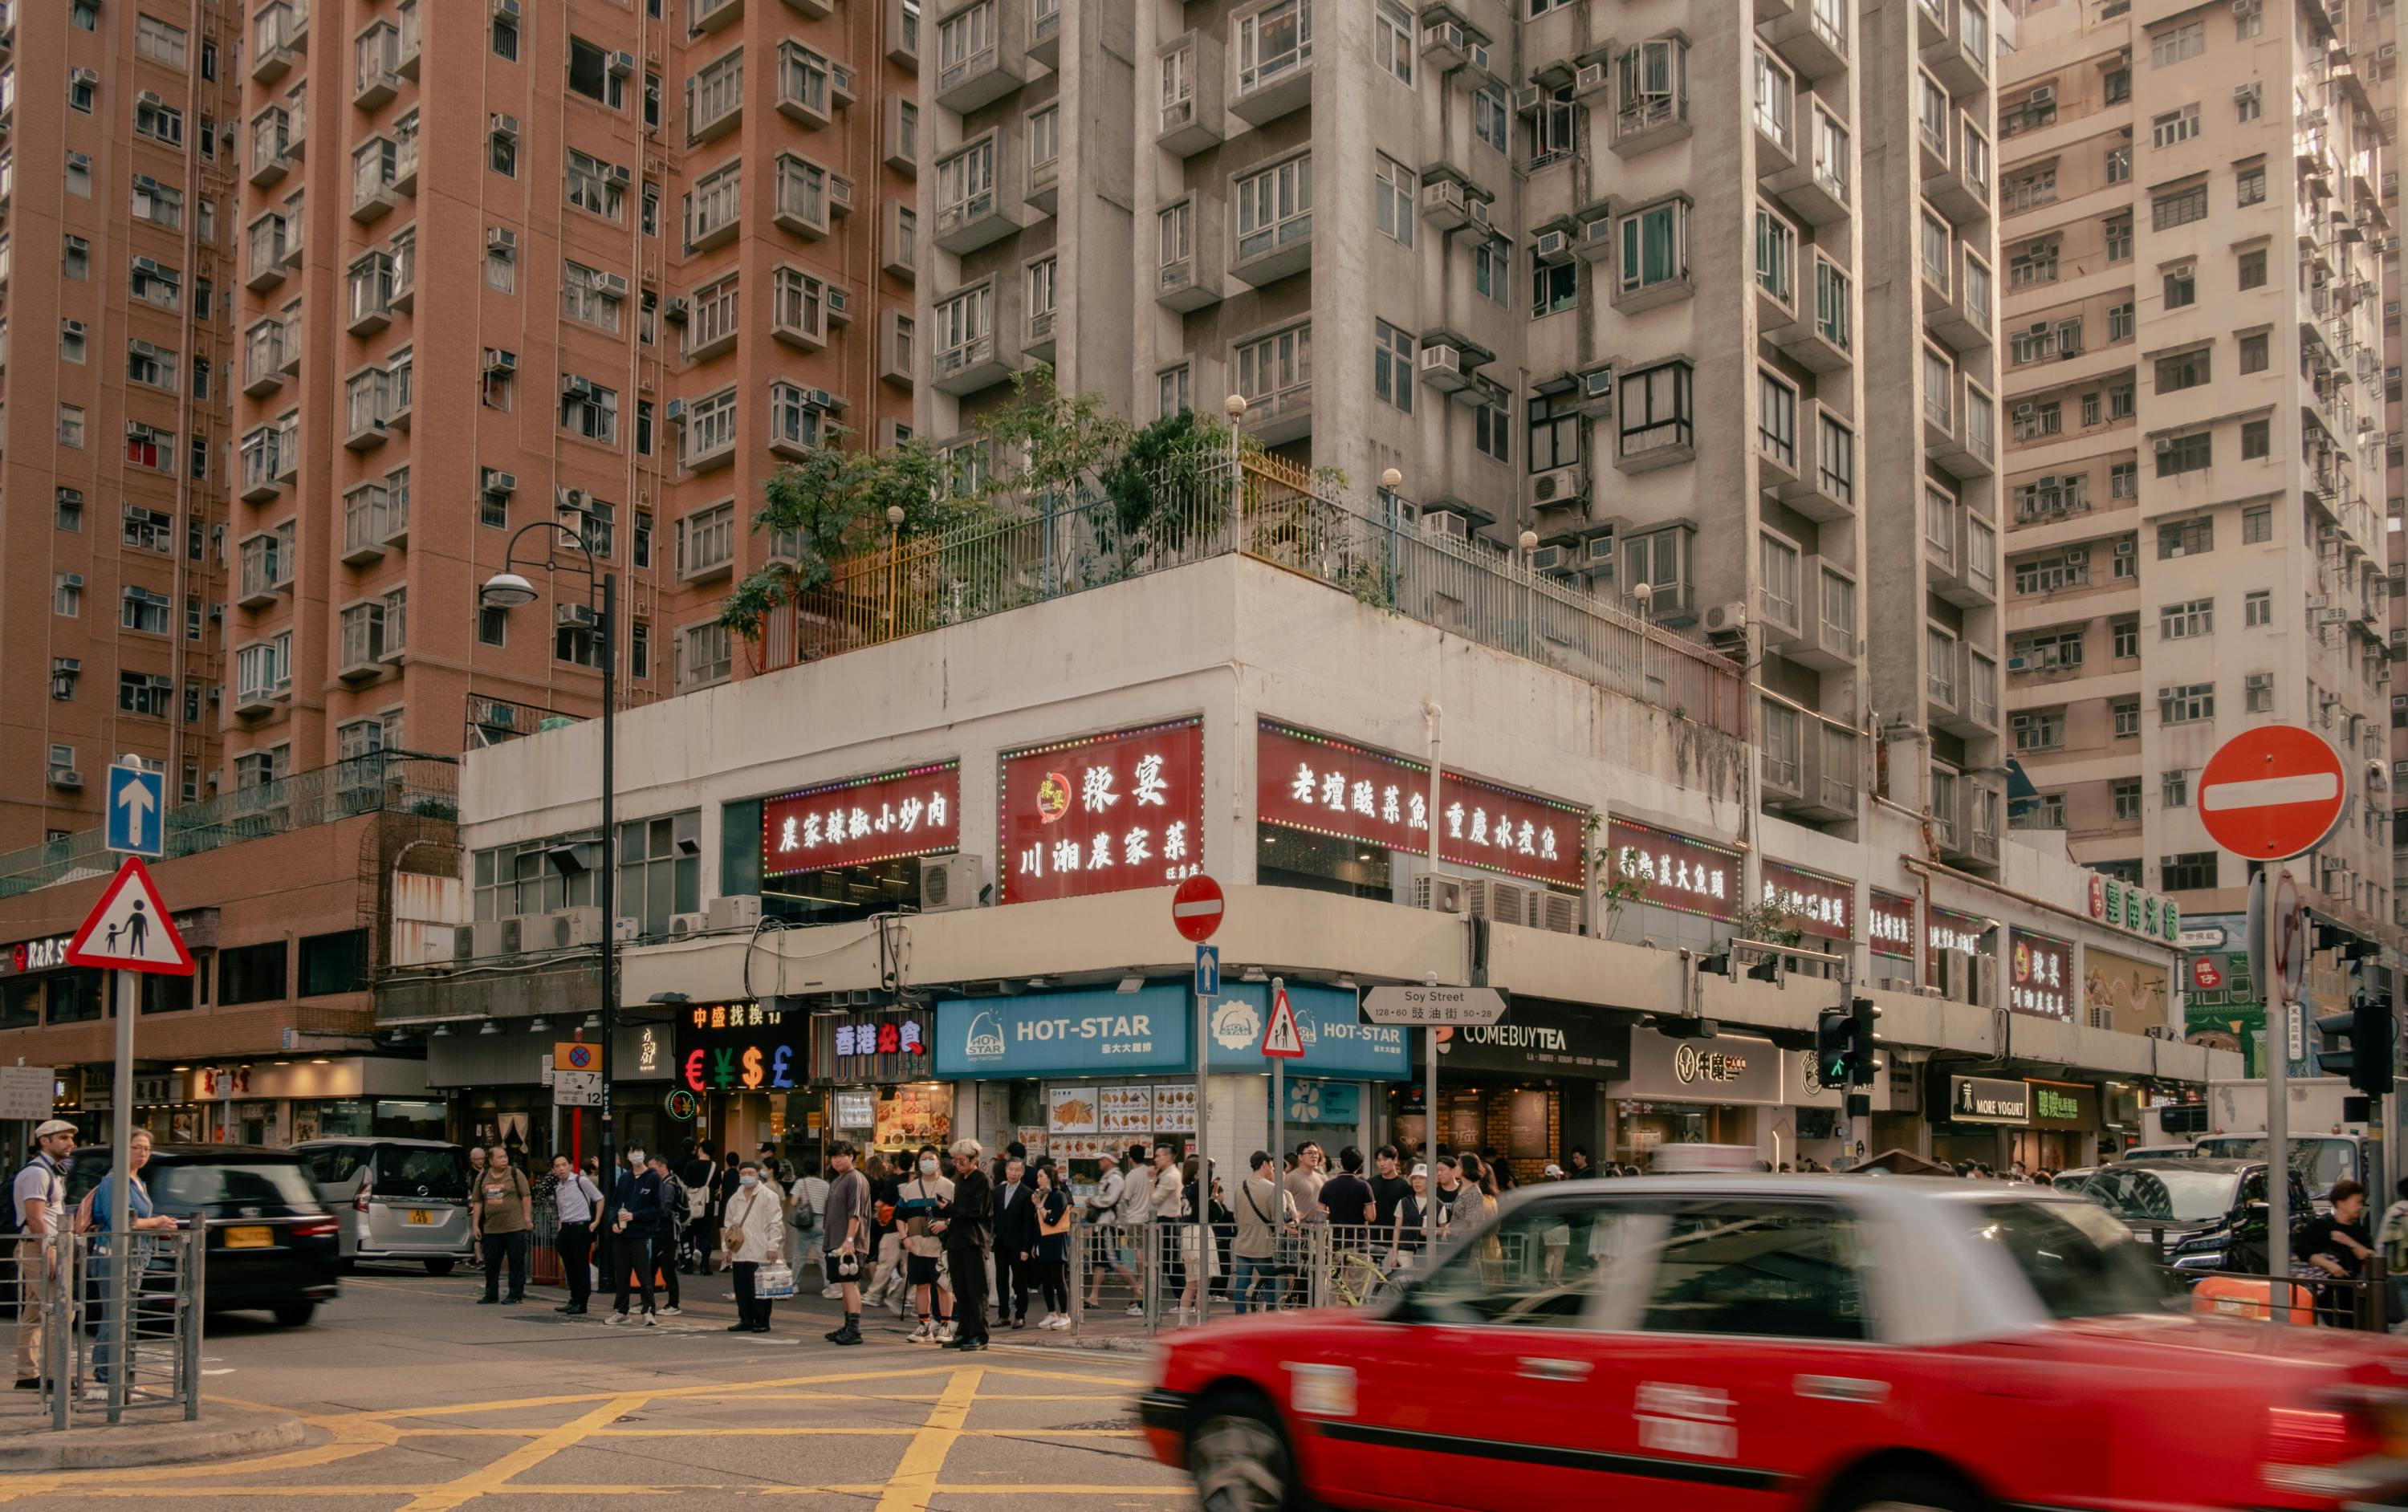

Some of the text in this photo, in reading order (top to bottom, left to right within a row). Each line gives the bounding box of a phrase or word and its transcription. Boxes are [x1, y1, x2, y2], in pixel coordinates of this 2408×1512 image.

[779, 791, 948, 853] 農家辣椒小炒肉
[1291, 762, 1558, 862] 老壇酸菜魚 重慶水煮魚
[1019, 820, 1187, 877] 川湘農家菜
[27, 937, 54, 969] R&R
[1405, 991, 1464, 1002] Soy Street
[1411, 1008, 1458, 1020] 豉油街
[1017, 1014, 1151, 1042] HOT-STAR
[1324, 1022, 1401, 1043] HOT-STAR
[1463, 1025, 1567, 1051] COMEBUYTEA
[968, 1045, 1002, 1055] STAR
[971, 1034, 999, 1047] HOT
[587, 1092, 600, 1104] 12
[1976, 1099, 2024, 1116] MORE YOGURT
